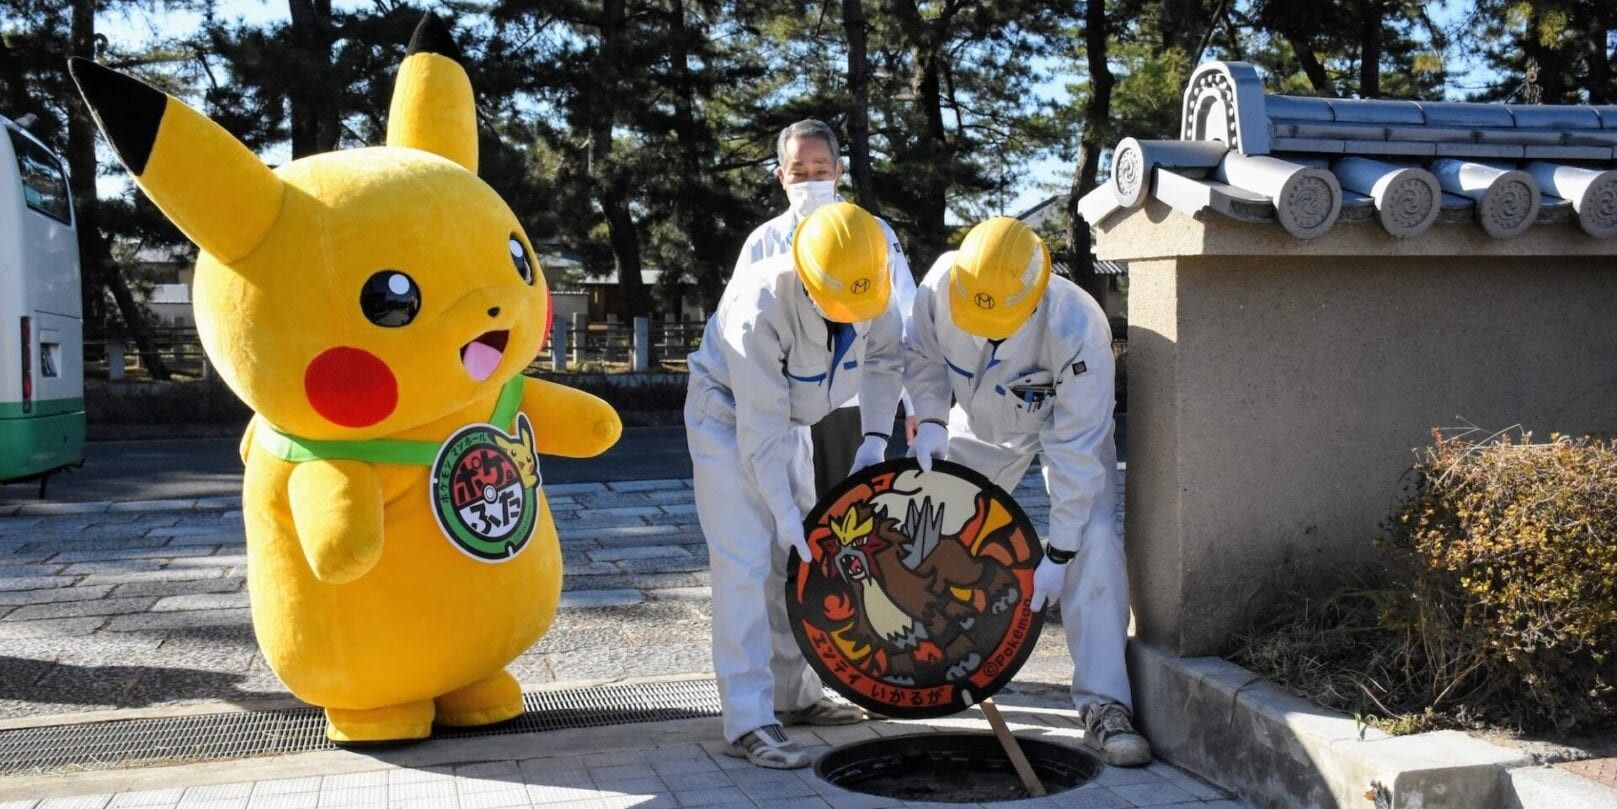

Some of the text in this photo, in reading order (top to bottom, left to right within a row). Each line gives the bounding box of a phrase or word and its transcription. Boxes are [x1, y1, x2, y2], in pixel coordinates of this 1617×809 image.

[439, 433, 488, 504] ポケモン マンホール
[870, 684, 944, 705] いかるが
